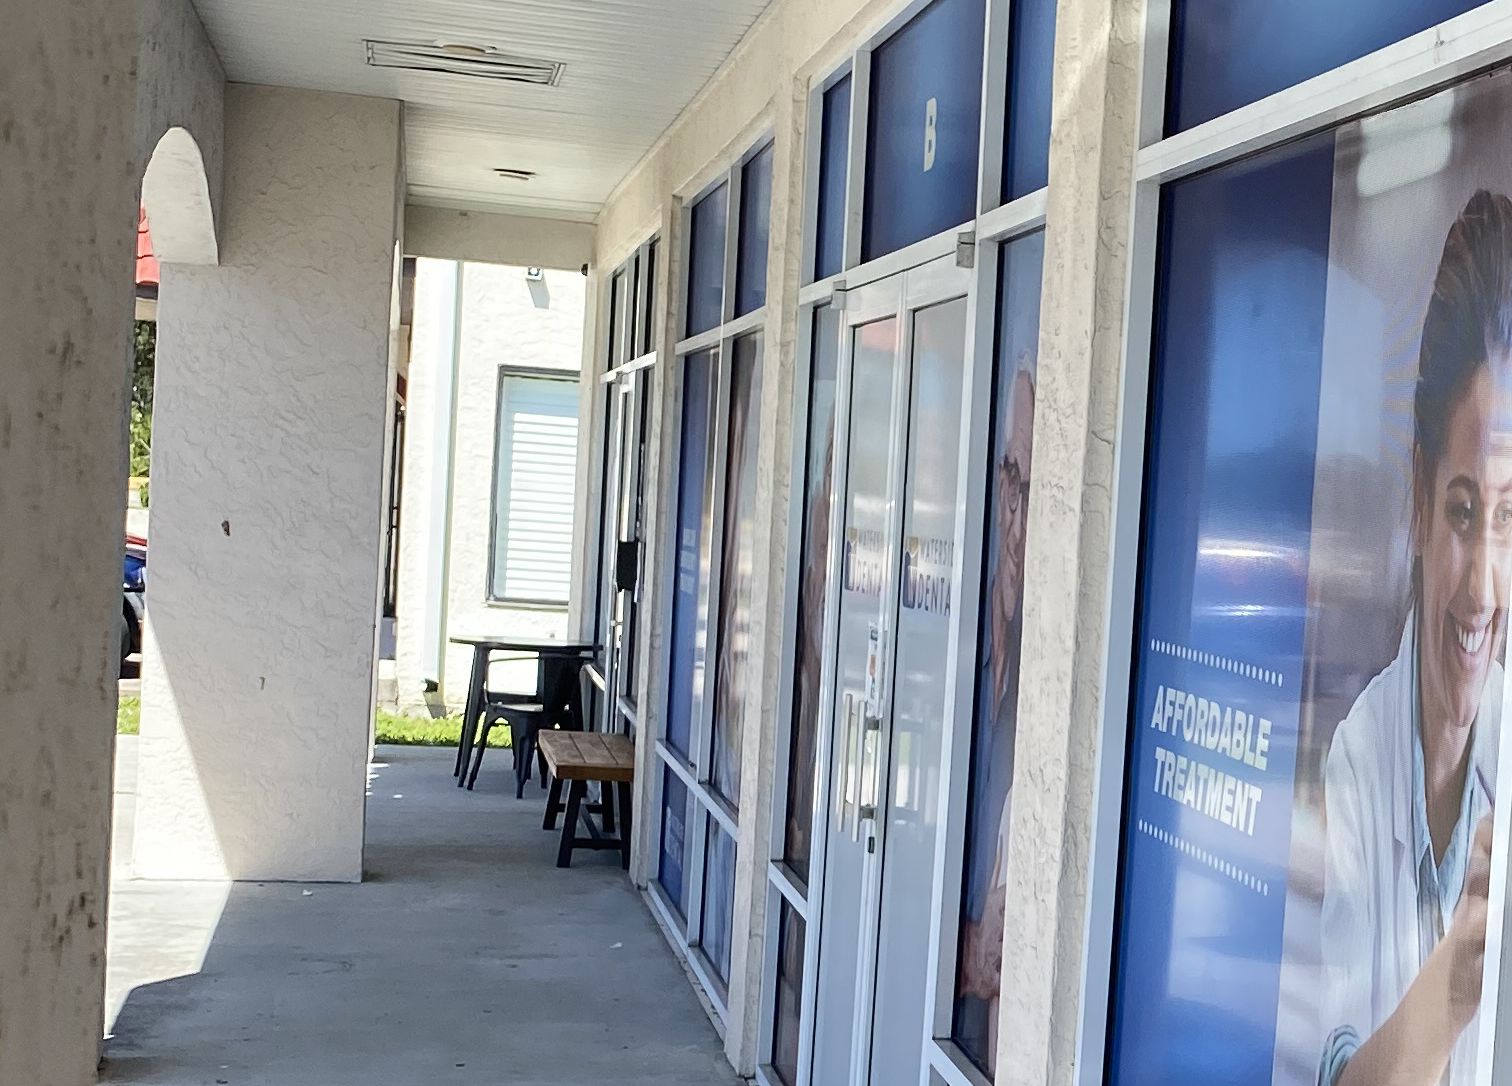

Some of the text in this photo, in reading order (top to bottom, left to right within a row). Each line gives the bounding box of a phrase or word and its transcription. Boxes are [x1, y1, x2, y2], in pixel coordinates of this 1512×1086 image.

[923, 97, 937, 172] B
[917, 573, 951, 616] DENTA
[1151, 685, 1272, 771] AFFORDABLE
[1154, 746, 1262, 836] TREATMENT
